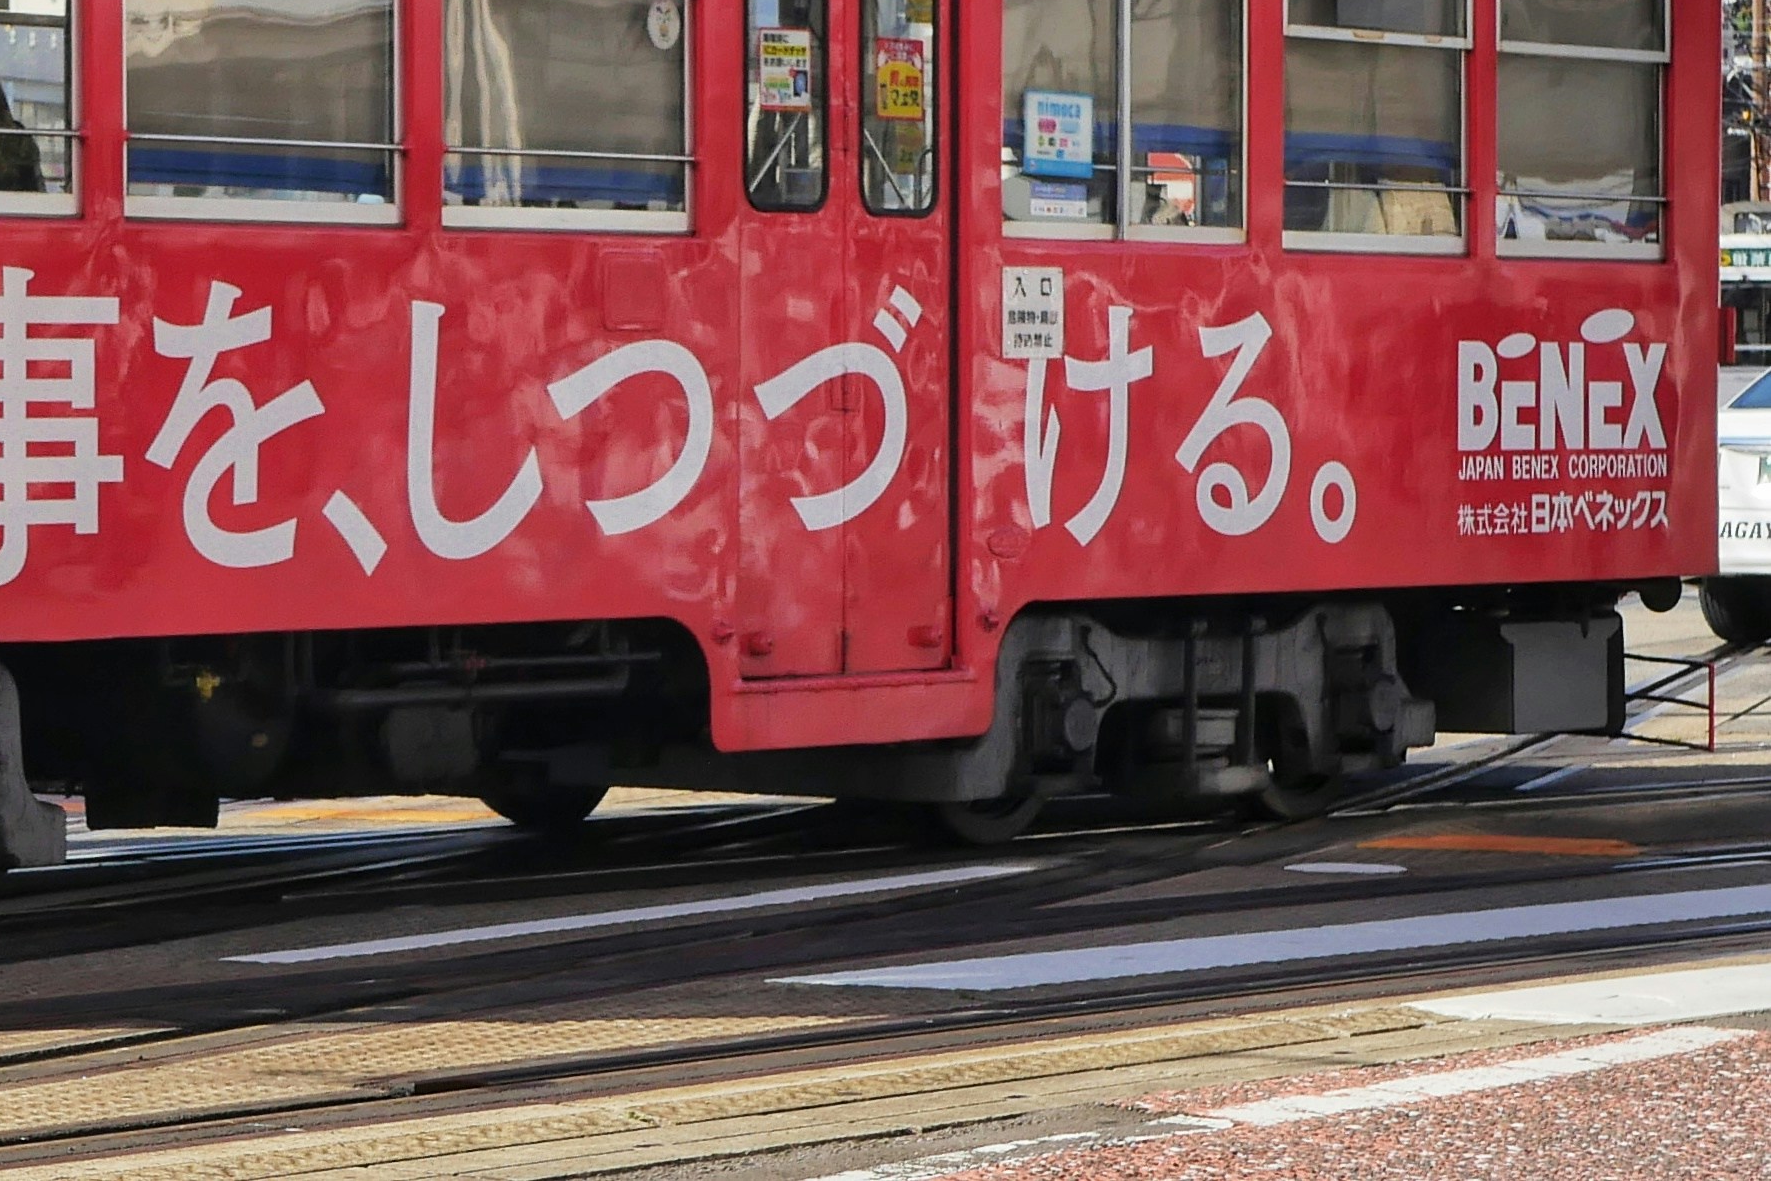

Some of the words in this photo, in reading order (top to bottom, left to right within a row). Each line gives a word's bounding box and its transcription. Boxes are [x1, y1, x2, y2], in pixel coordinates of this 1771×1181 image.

[1013, 277, 1053, 297] 入口
[1458, 456, 1504, 481] JAPAN
[1512, 455, 1560, 480] BENEX
[1568, 454, 1668, 479] CORPORATION
[1457, 490, 1670, 536] 株式会社日本ベネックス
